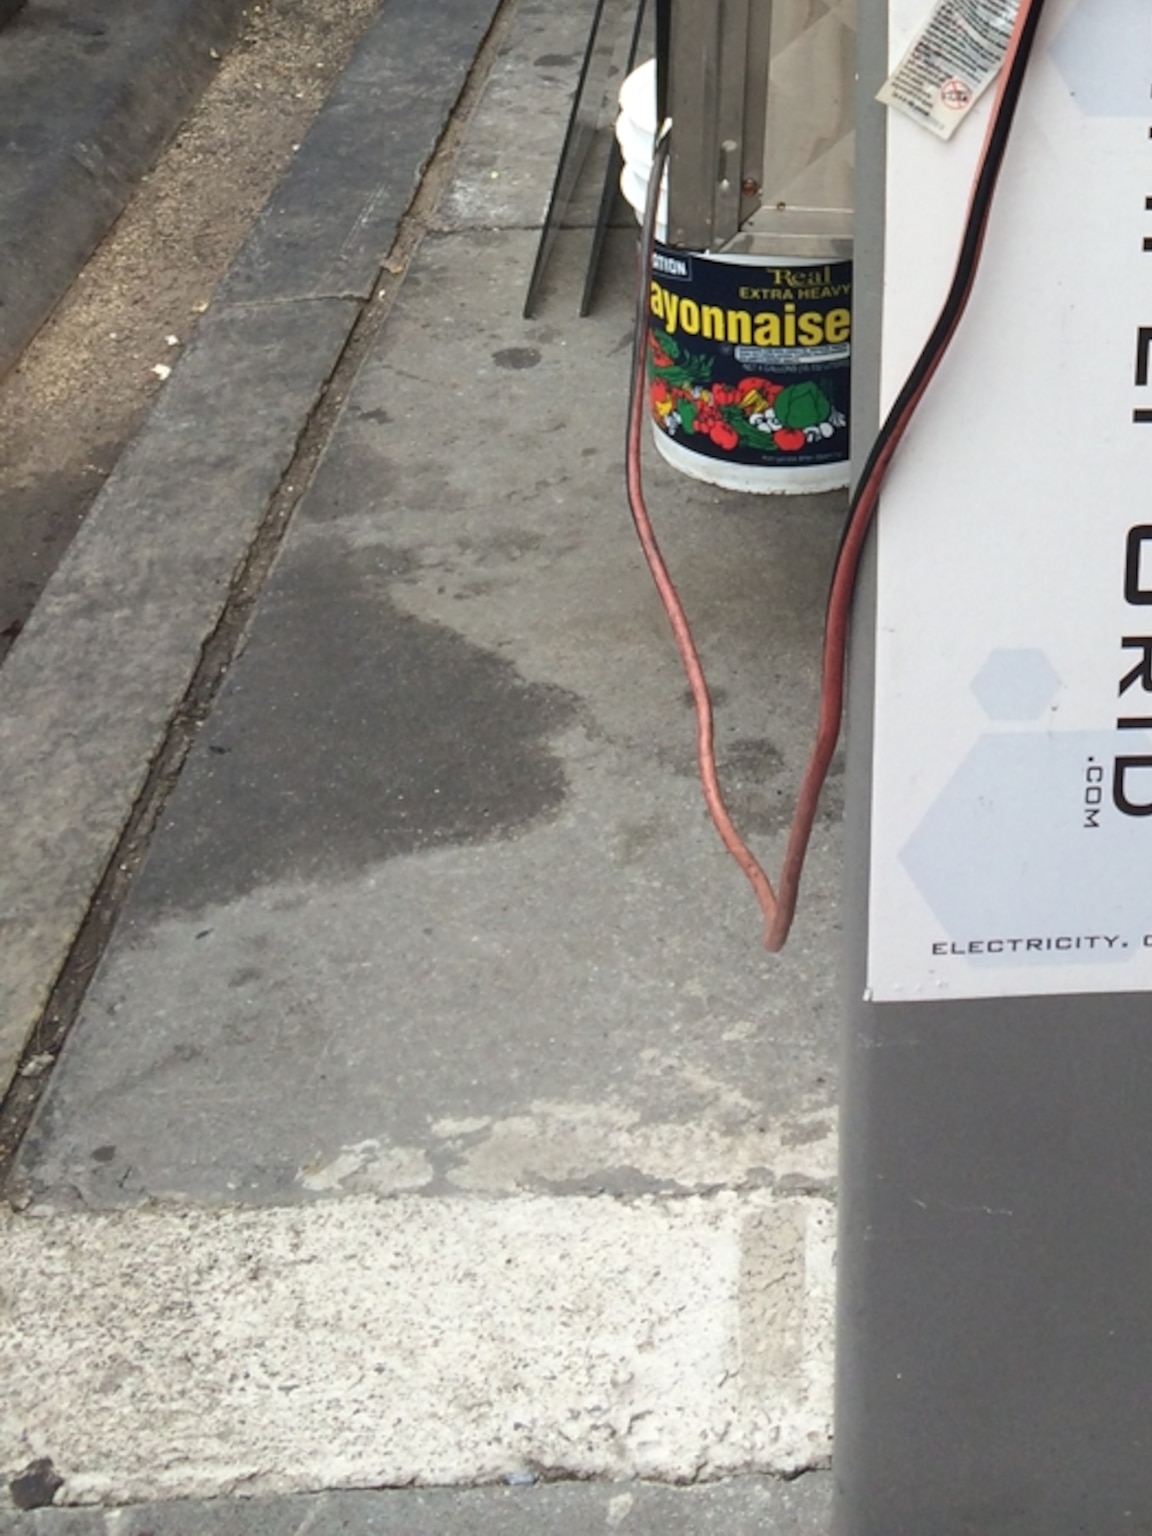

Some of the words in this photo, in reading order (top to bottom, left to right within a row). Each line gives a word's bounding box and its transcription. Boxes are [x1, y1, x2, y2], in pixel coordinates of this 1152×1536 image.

[768, 266, 831, 288] Real
[739, 286, 793, 300] EXTRA
[798, 283, 850, 300] HEAVY
[650, 280, 850, 347] ayonnaise
[1083, 756, 1103, 829] .COM
[932, 935, 1128, 956] ELECTRICITY.
